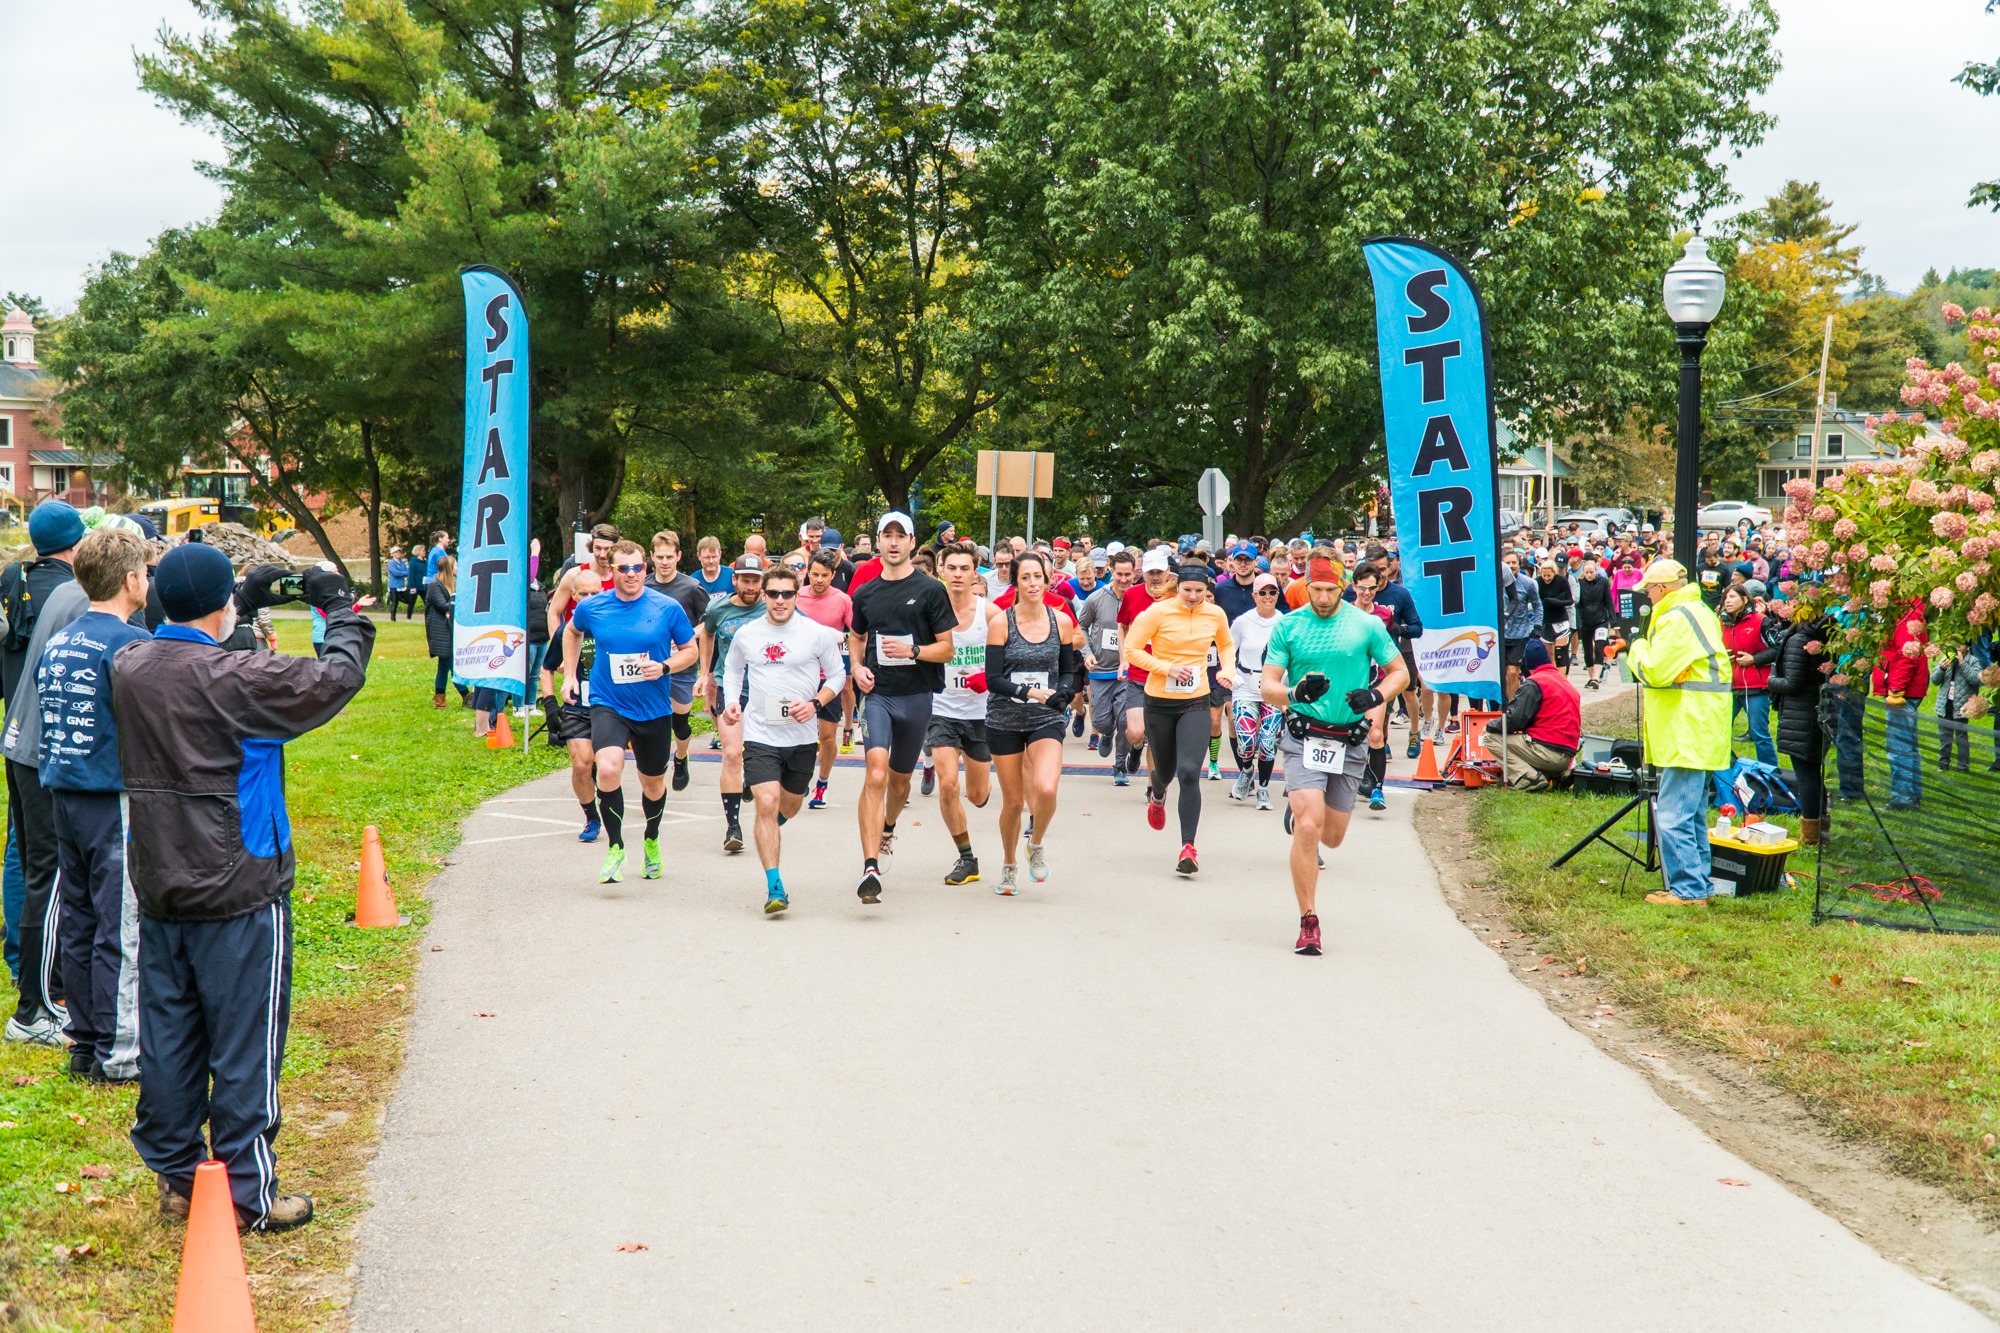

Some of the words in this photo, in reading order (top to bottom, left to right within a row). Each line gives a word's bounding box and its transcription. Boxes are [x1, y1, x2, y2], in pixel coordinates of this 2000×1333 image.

[1404, 268, 1476, 616] START
[470, 293, 514, 615] START
[965, 645, 985, 656] Fine
[1420, 648, 1450, 660] GRANITE
[964, 654, 985, 666] Club
[1433, 657, 1469, 670] SERVICES
[619, 664, 642, 677] 132
[66, 716, 95, 727] GNC
[1312, 748, 1336, 764] 367
